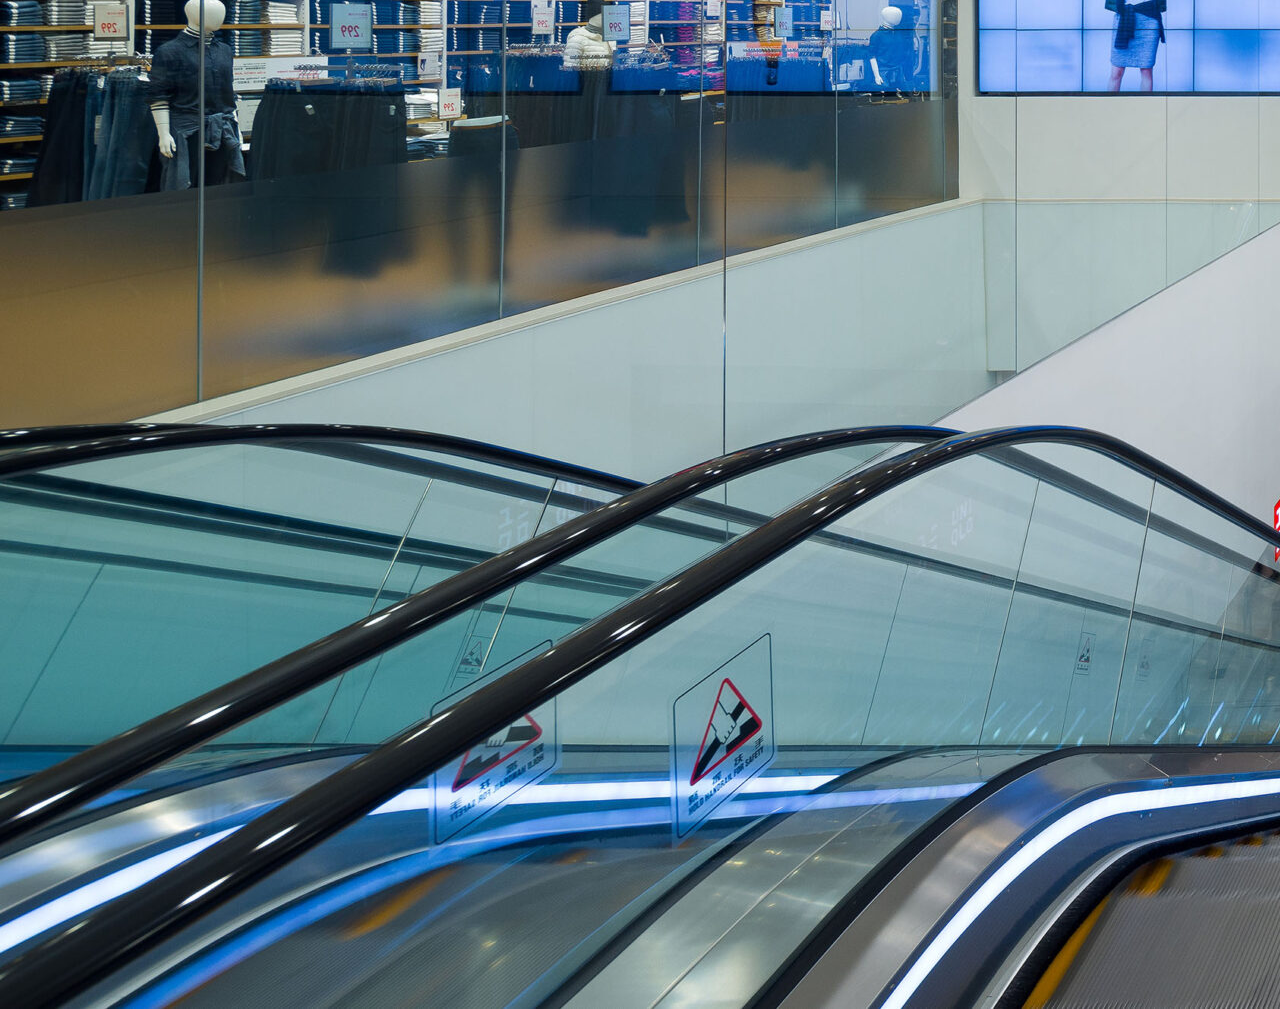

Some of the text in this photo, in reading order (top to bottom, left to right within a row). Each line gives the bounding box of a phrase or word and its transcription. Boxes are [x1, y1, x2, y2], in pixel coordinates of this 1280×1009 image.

[688, 798, 704, 815] HOLD
[733, 762, 745, 777] FOR
[745, 746, 764, 767] SAFETY
